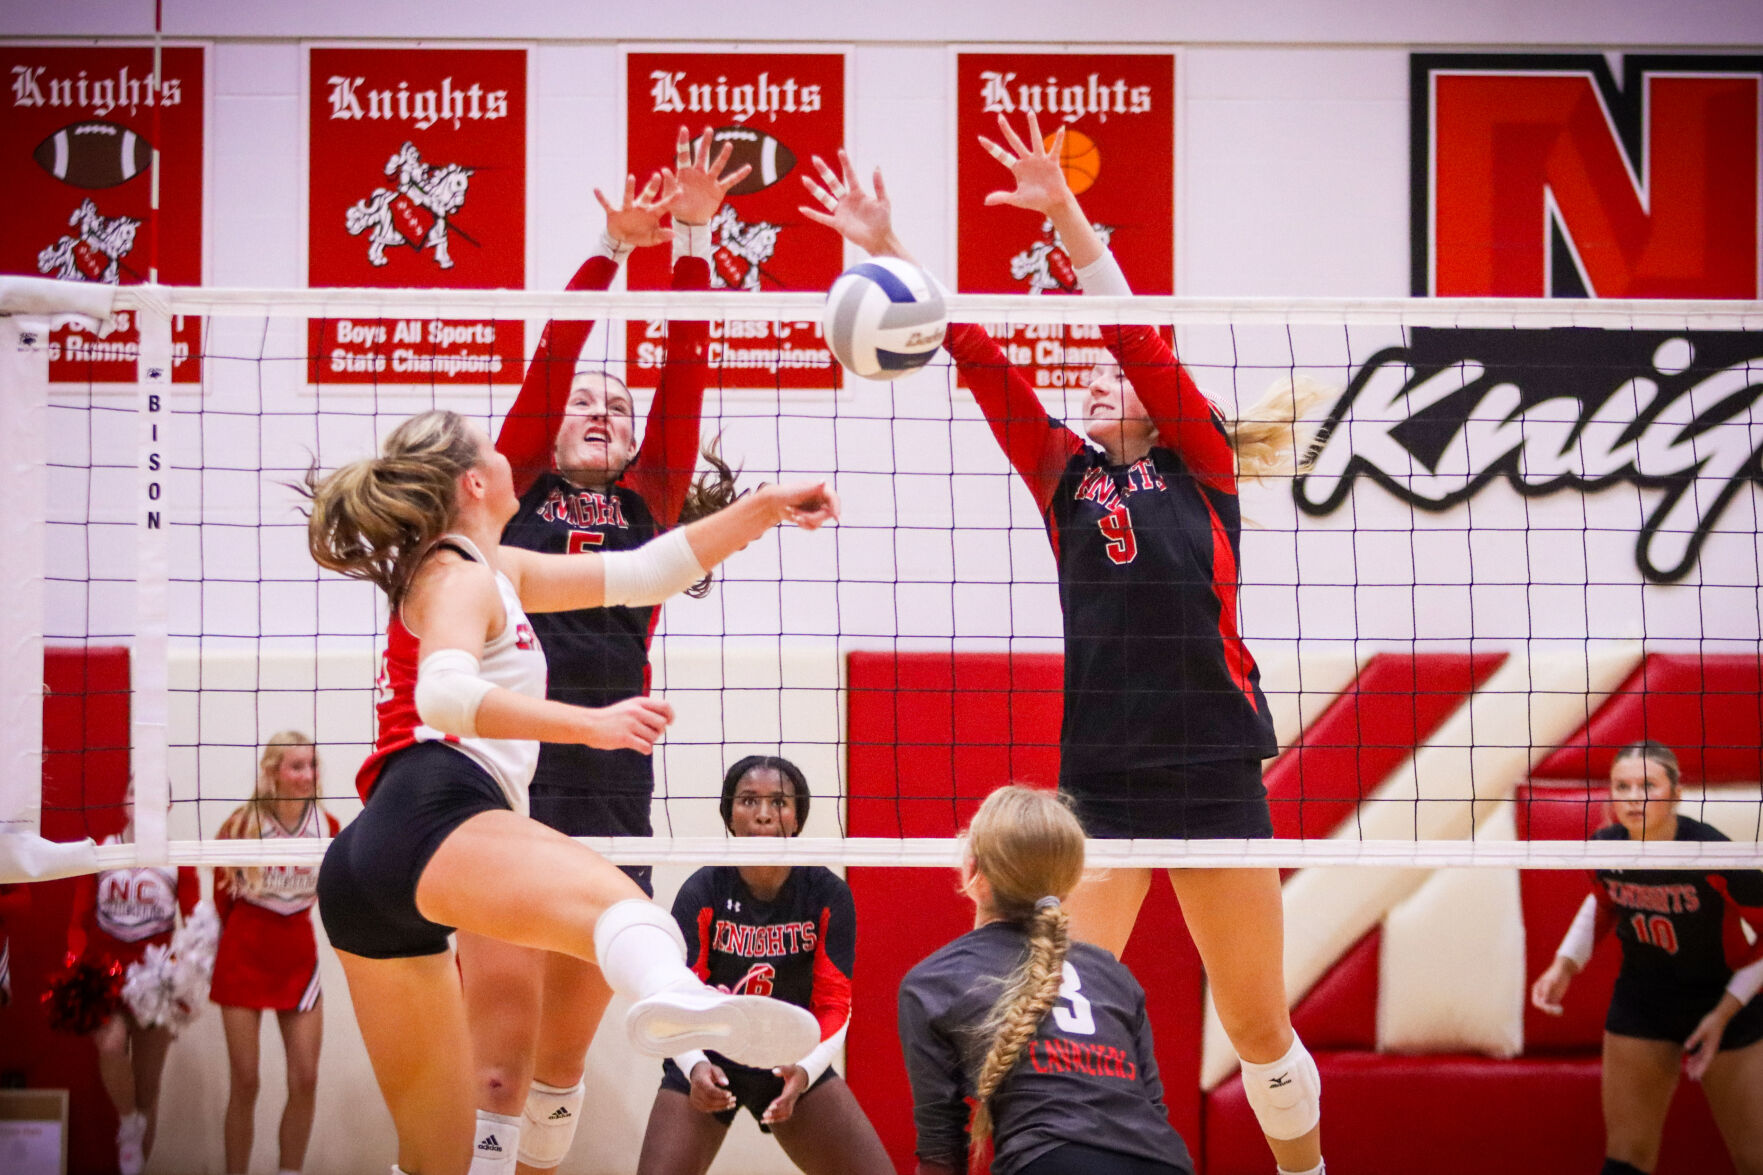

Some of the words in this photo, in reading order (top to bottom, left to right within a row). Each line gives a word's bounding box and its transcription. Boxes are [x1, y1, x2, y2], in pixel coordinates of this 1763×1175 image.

[10, 65, 182, 117] Knights
[327, 75, 508, 131] Knights
[650, 70, 821, 123] Knights
[980, 71, 1151, 124] Knights
[337, 320, 386, 348] Boys
[393, 320, 422, 344] All
[428, 320, 495, 348] Sports
[708, 342, 831, 373] Champions
[331, 349, 386, 372] State
[392, 349, 502, 377] Champions
[147, 394, 161, 529] BISON
[1292, 338, 1763, 585] Knig
[1097, 503, 1138, 565] 9
[712, 920, 818, 957] KNIGHTS
[1631, 912, 1680, 956] 10
[744, 962, 776, 996] 6
[1051, 959, 1096, 1036] 3
